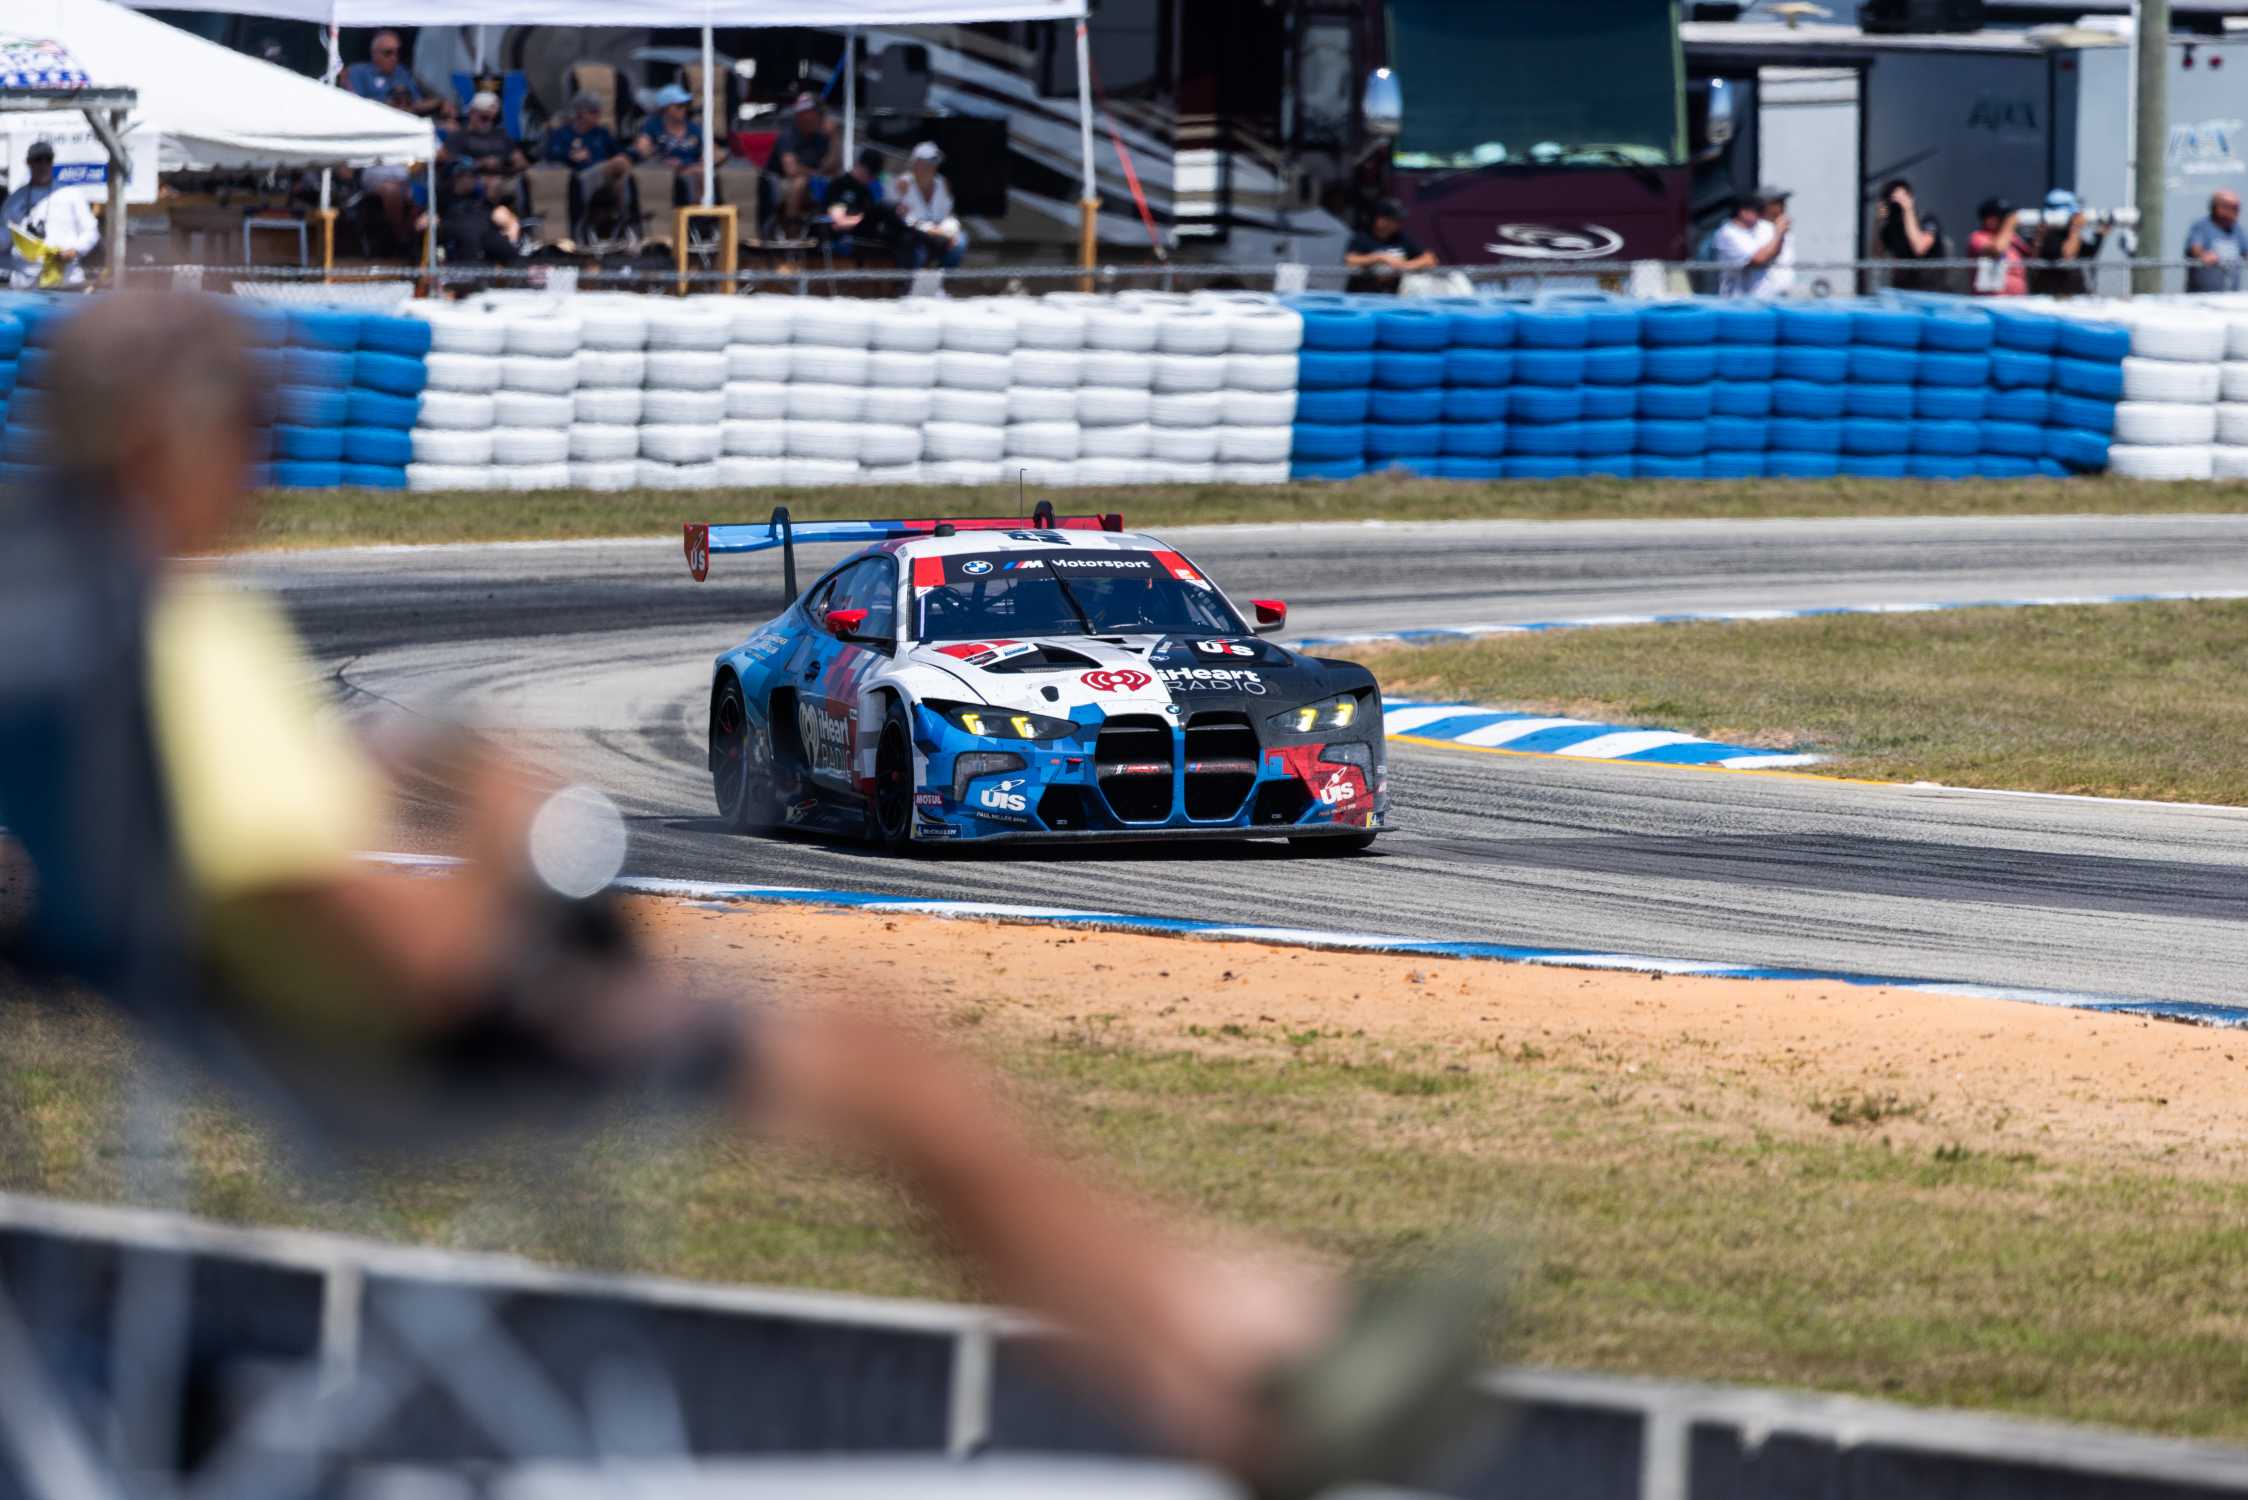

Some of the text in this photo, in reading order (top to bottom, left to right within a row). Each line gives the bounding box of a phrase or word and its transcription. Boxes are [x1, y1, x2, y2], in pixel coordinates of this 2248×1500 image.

[1051, 559, 1152, 569] Motorsport
[1157, 667, 1261, 683] iHeart
[1163, 680, 1267, 695] RADIO
[818, 707, 850, 746] iHeart
[916, 793, 943, 805] MOTUL
